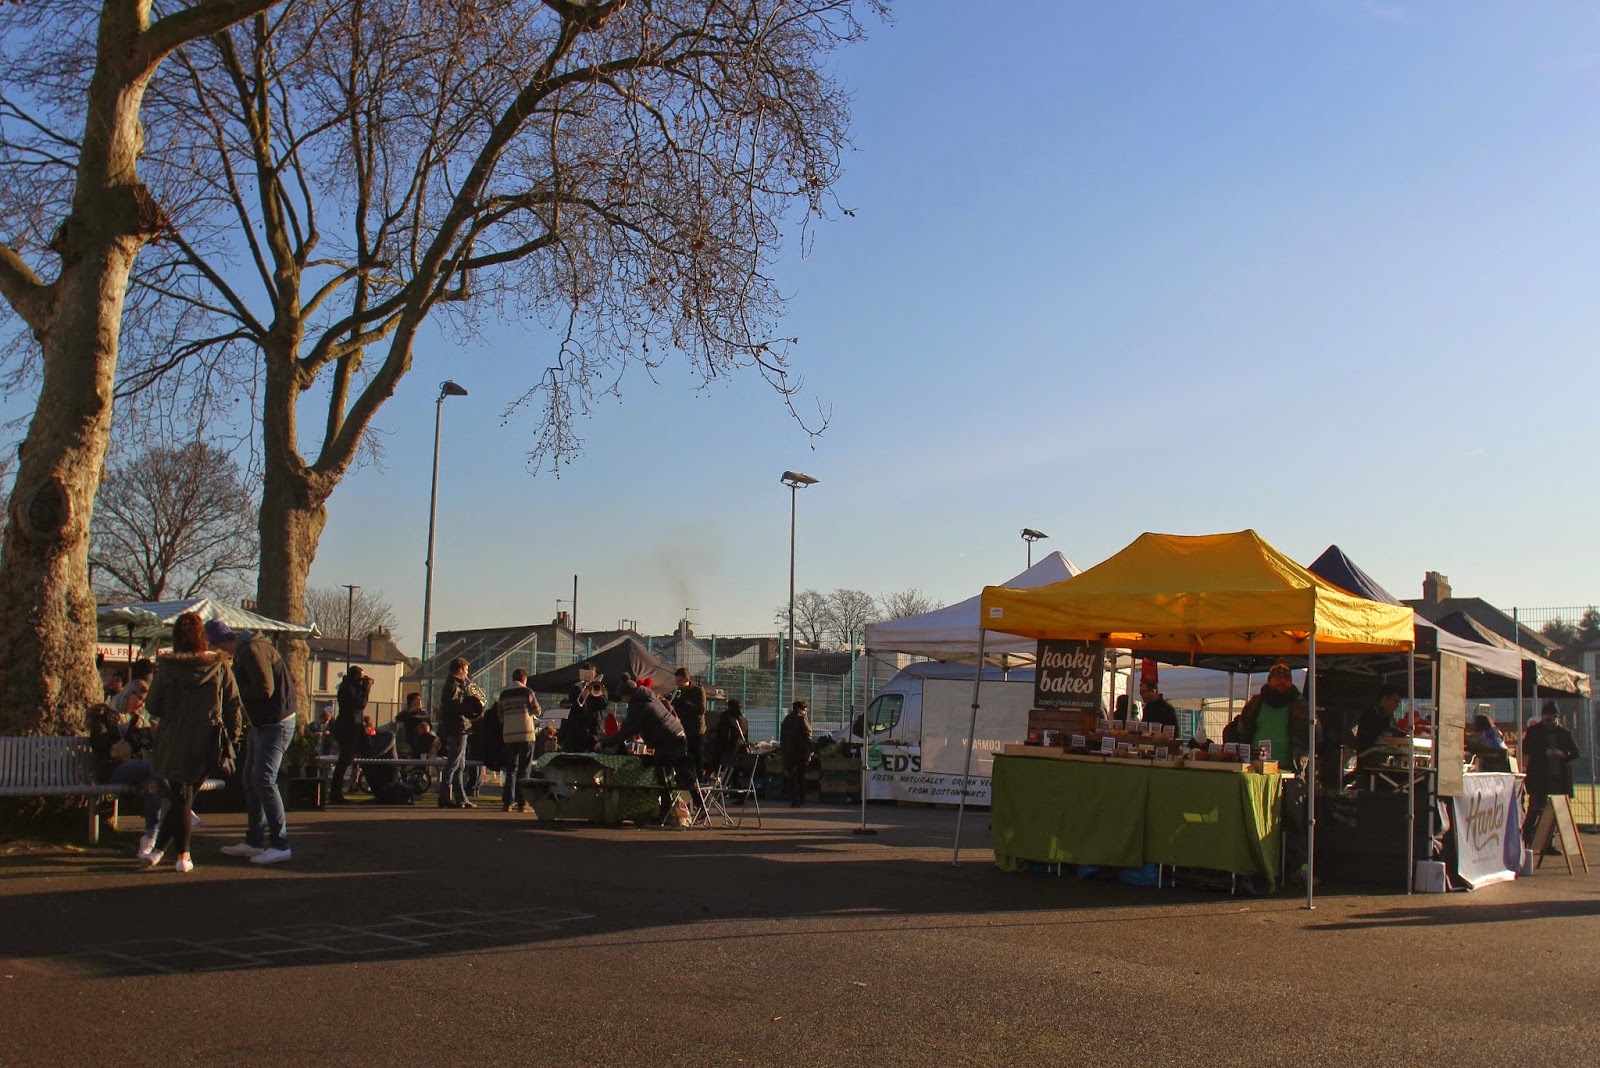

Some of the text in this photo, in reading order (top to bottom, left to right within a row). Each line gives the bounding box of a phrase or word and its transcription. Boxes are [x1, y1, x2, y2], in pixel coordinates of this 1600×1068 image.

[1041, 646, 1096, 677] kooky
[1040, 670, 1094, 694] bakes
[871, 754, 922, 773] ED'S
[899, 775, 945, 785] NATURALLY
[907, 786, 928, 795] FROM
[930, 787, 960, 797] BOSTON
[1465, 791, 1504, 850] Hanks
